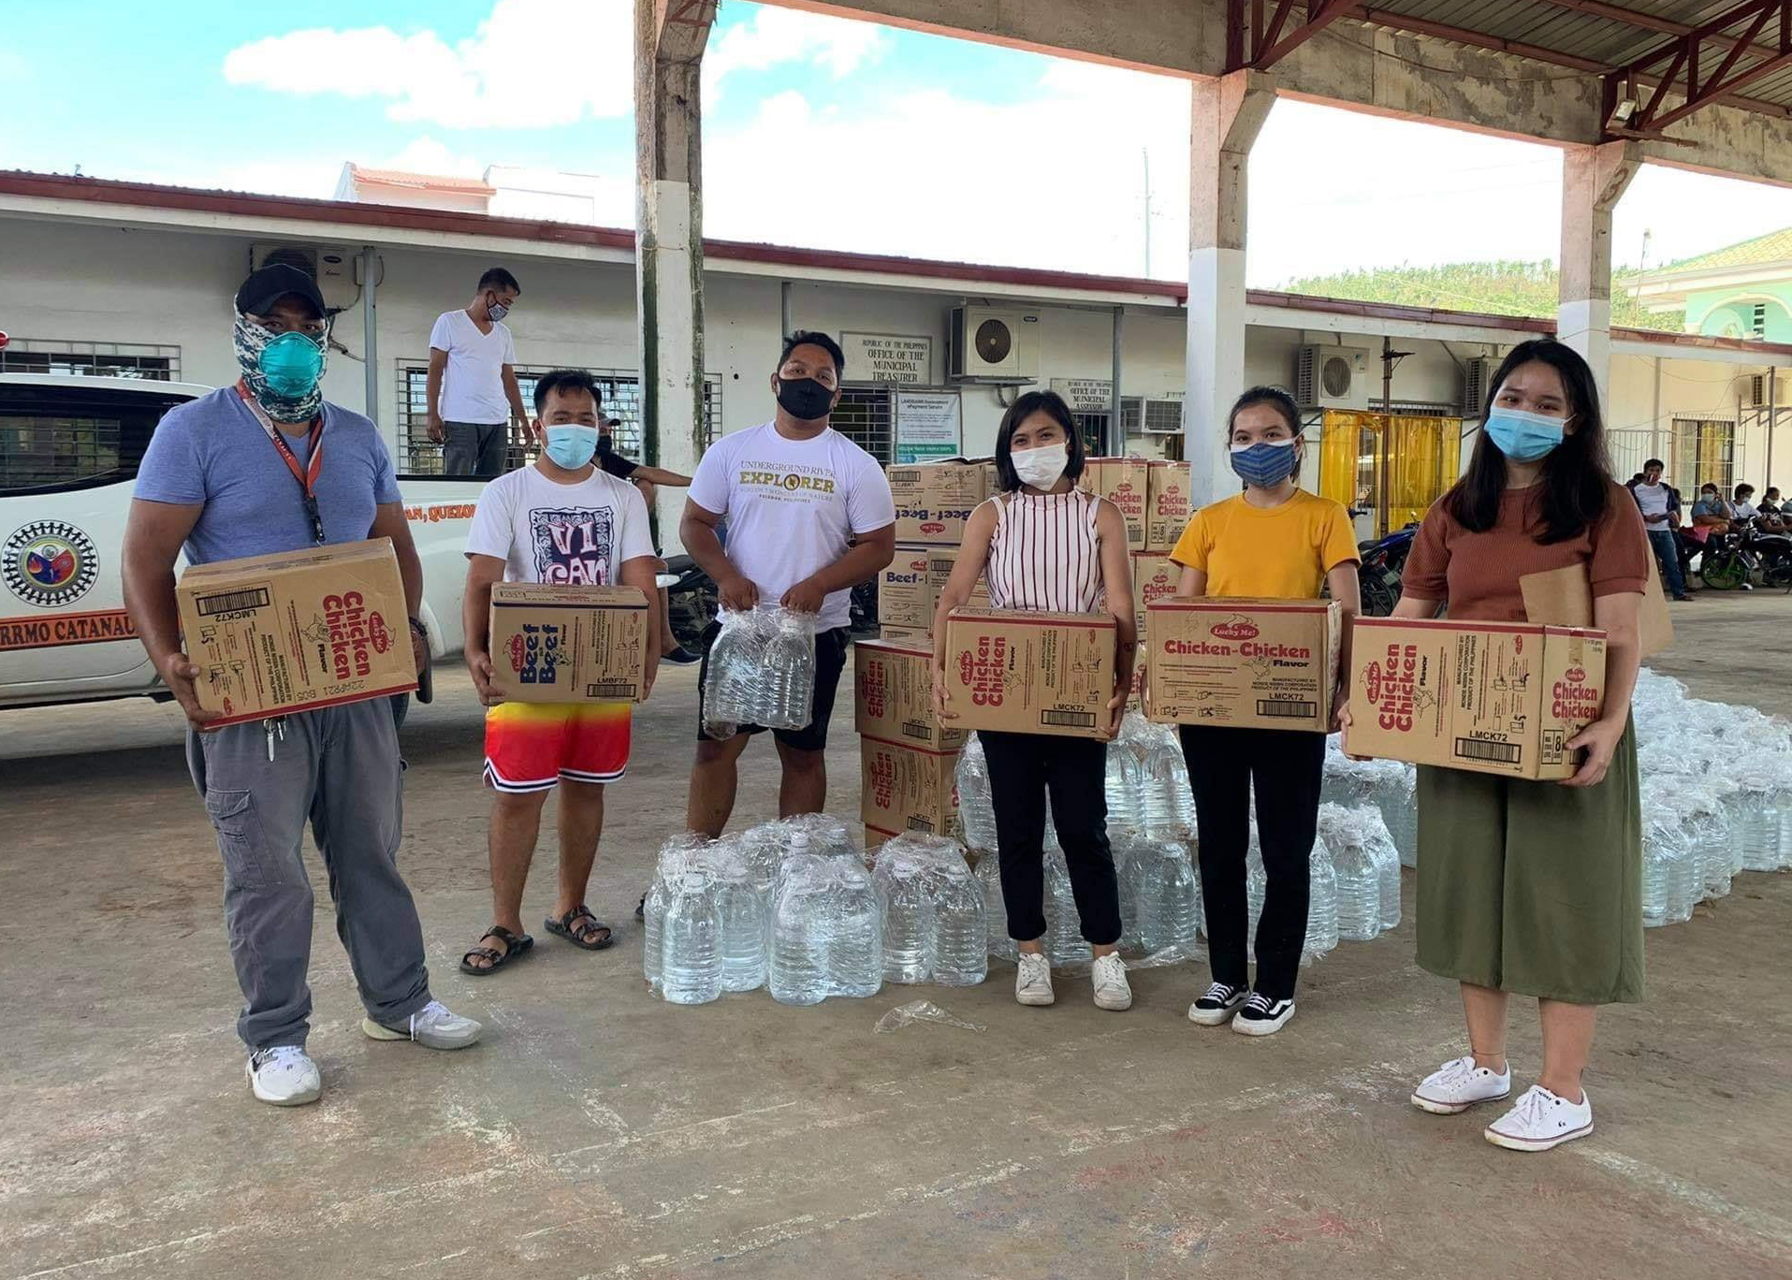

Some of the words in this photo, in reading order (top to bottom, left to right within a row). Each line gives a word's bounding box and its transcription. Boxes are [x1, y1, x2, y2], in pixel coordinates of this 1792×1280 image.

[868, 349, 894, 359] OFFICE
[896, 350, 907, 360] OF
[909, 351, 925, 361] THE
[873, 360, 917, 371] MUNICIPAL
[872, 371, 918, 383] TREASURER
[740, 460, 810, 474] UNDERGROUND
[740, 471, 835, 494] EXPLORER
[1109, 491, 1142, 503] Chicken
[1157, 494, 1188, 505] Chicken
[1119, 503, 1142, 514] icken
[1157, 505, 1188, 516] Chicken
[548, 521, 598, 555] VI
[1142, 583, 1177, 594] Chicken
[215, 609, 257, 623] LMCK72
[0, 622, 50, 646] RRMO
[323, 595, 350, 680] Chicken
[343, 591, 371, 676] Chicken
[1213, 627, 1240, 637] Lucky
[317, 643, 327, 674] Flavor
[520, 623, 540, 683] Beef
[539, 624, 559, 684] Beef
[972, 636, 990, 706] Chicken
[988, 637, 1006, 707] Chicken
[1272, 659, 1310, 668] Flavor
[1419, 655, 1428, 686] Flavor
[868, 660, 876, 717] Chicken
[875, 661, 884, 718] Chicken
[1378, 643, 1400, 730] Chicken
[1395, 644, 1417, 732] Chicken
[1553, 682, 1598, 701] Chicken
[1268, 692, 1304, 701] LMCK72
[1053, 703, 1086, 712] LMCK72
[1552, 700, 1598, 720] Chicken
[1469, 730, 1508, 742] LMCK72
[1555, 735, 1562, 752] 8
